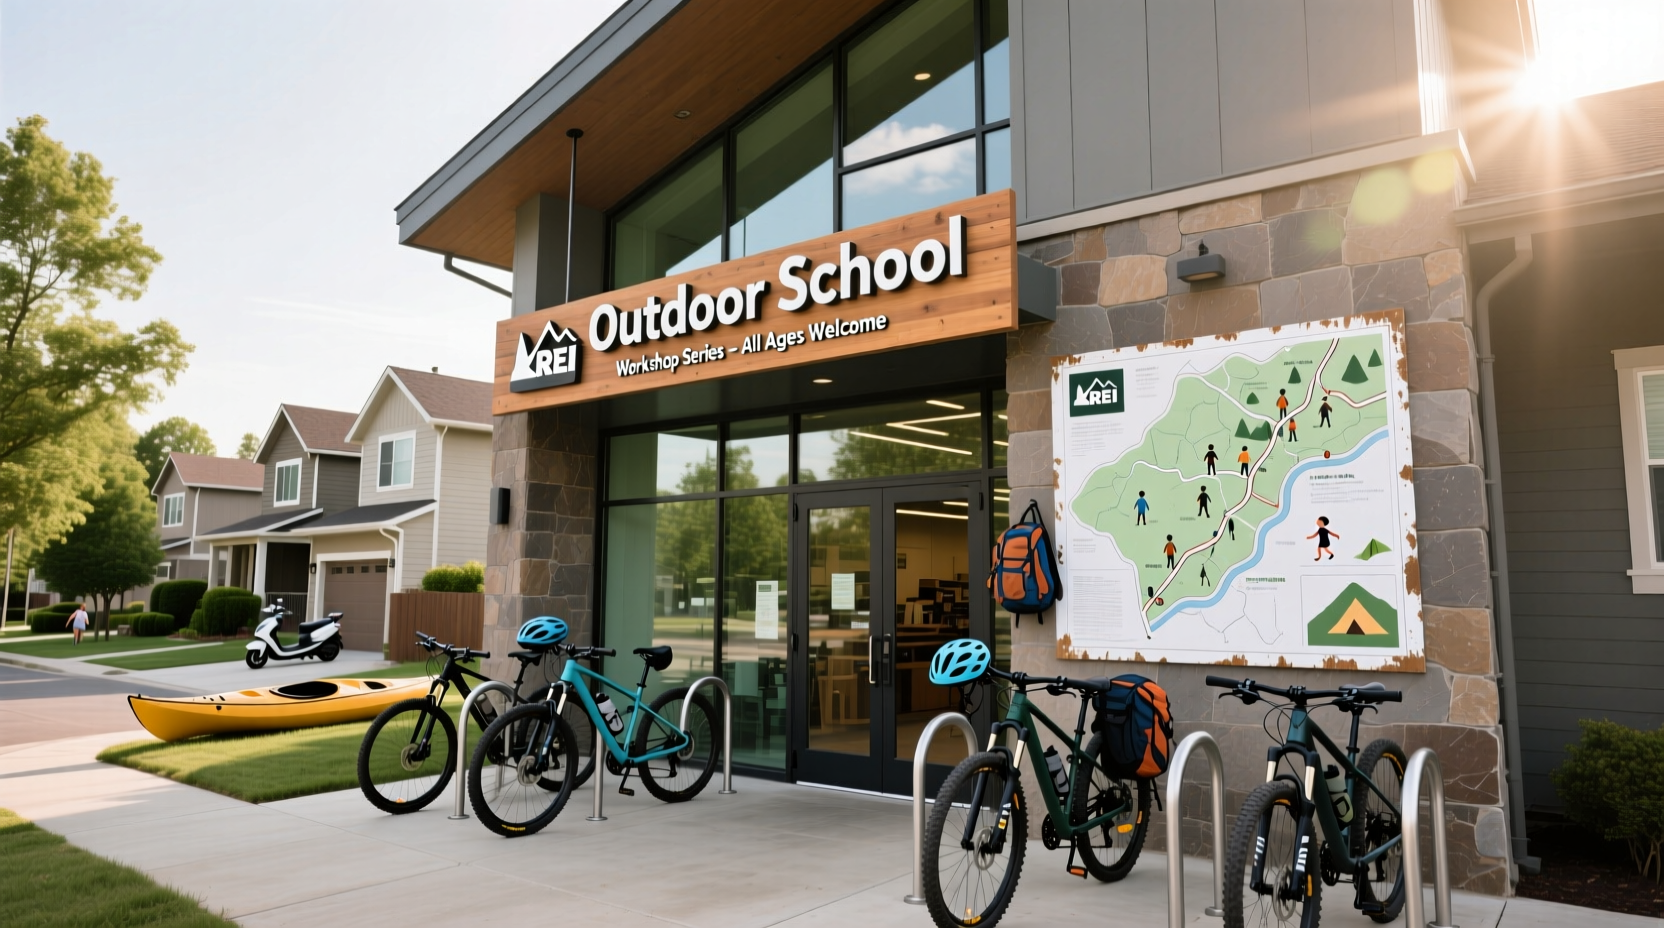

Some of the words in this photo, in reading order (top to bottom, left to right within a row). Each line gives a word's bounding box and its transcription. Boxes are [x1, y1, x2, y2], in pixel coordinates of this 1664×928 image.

[589, 280, 769, 352] Outdoor
[778, 215, 965, 311] School
[536, 345, 577, 378] REI
[616, 353, 679, 377] Workshop
[683, 344, 725, 366] Series
[742, 334, 762, 354] All
[766, 330, 805, 353] Ages
[809, 314, 887, 341] Welcome
[1089, 388, 1118, 406] REI
